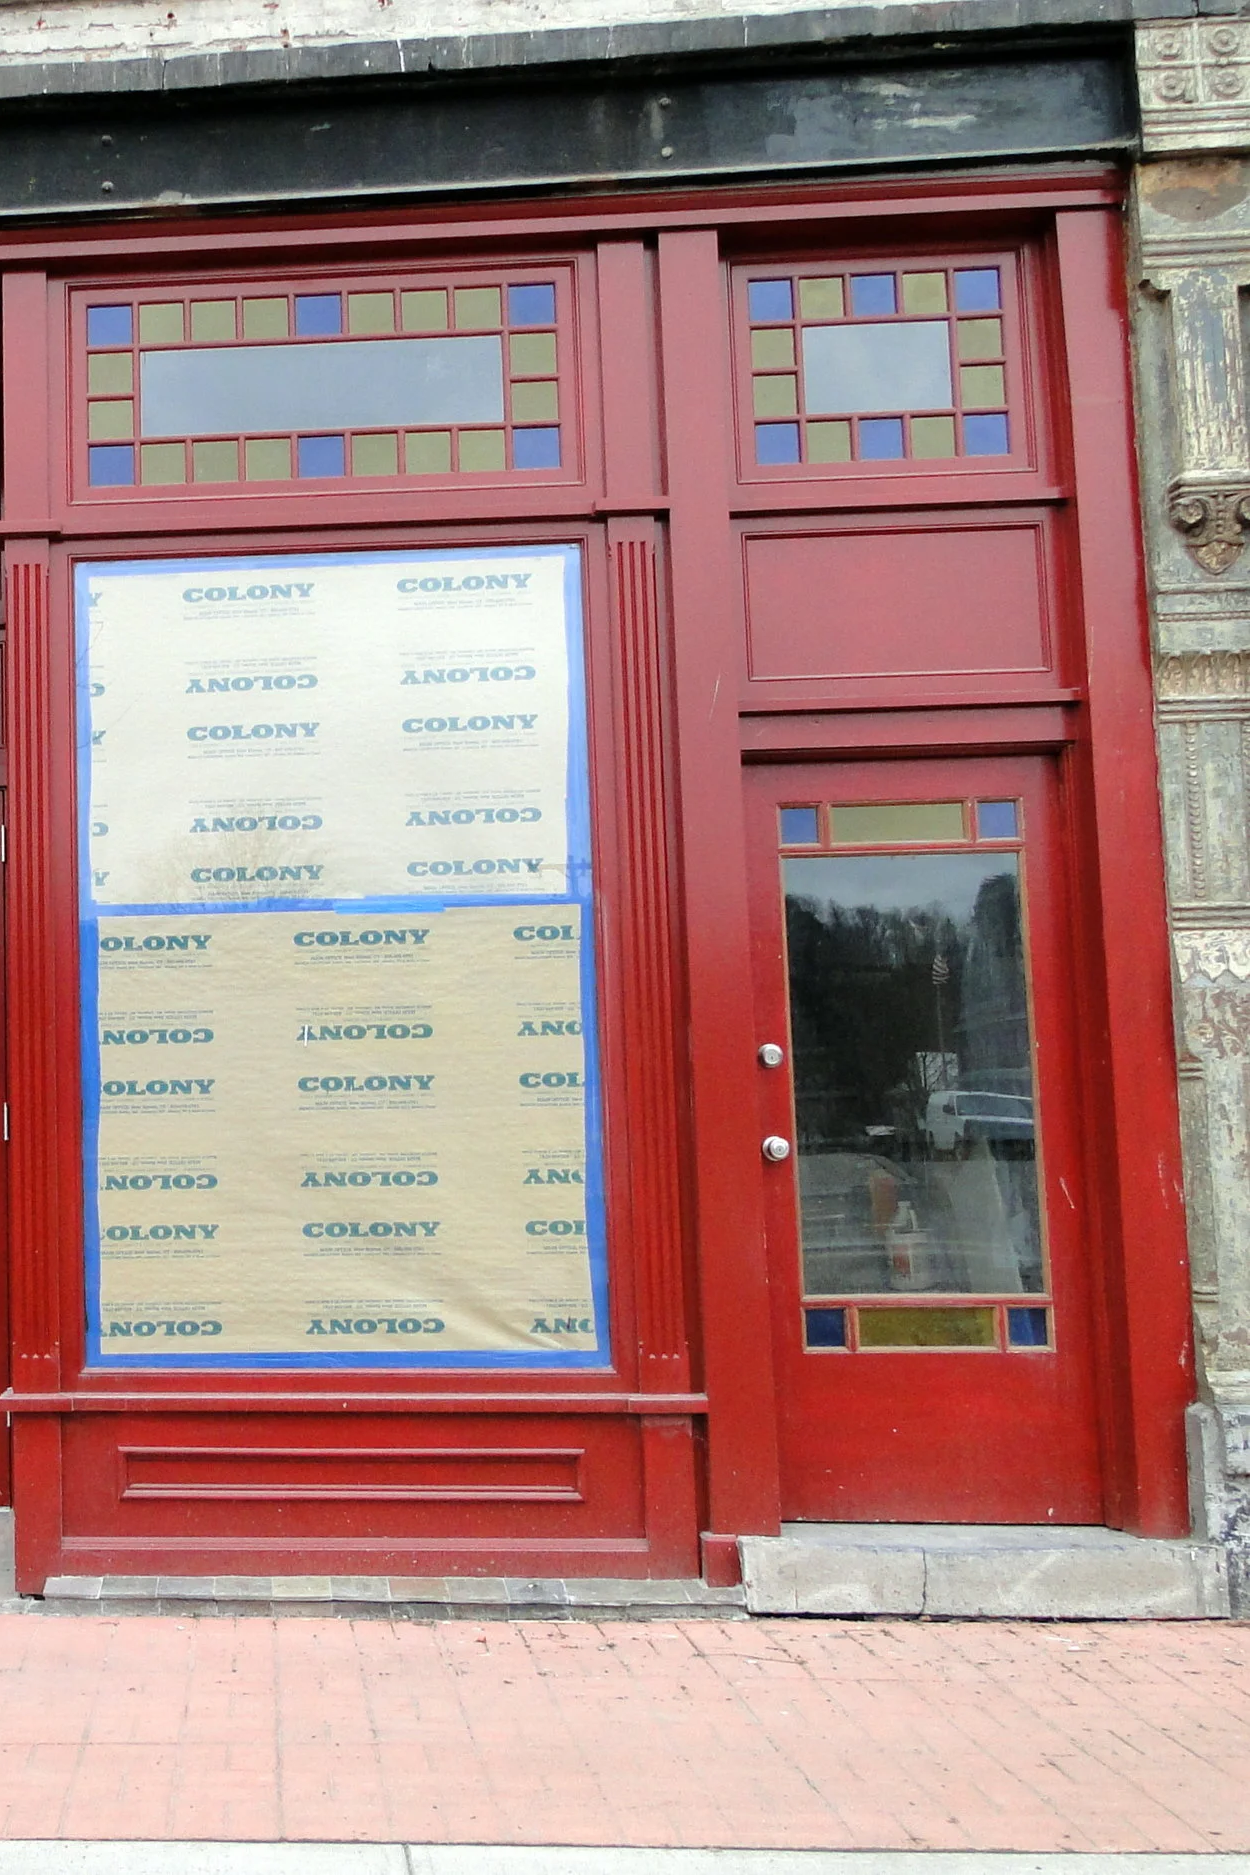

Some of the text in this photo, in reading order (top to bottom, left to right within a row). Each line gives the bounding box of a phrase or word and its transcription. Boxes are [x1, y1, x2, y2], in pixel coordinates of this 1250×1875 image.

[182, 582, 316, 603] COLONY
[396, 573, 531, 593] COLONY
[183, 674, 319, 695] COLONY
[398, 666, 536, 686] COLONY
[186, 721, 321, 741] COLONY
[402, 713, 540, 733] COLONY
[187, 815, 323, 834] COLONY
[403, 807, 542, 828] COLONY
[190, 863, 326, 883] COLONY
[406, 857, 545, 876] COLONY
[293, 927, 432, 947] COLONY
[100, 1028, 215, 1046] COLON
[295, 1023, 434, 1042] COLONY
[297, 1073, 437, 1092] COLONY
[101, 1173, 219, 1191] COLON
[299, 1170, 439, 1189] COLONY
[302, 1220, 441, 1239] COLONY
[100, 1319, 224, 1338] COLON
[304, 1317, 446, 1336] COLONY
